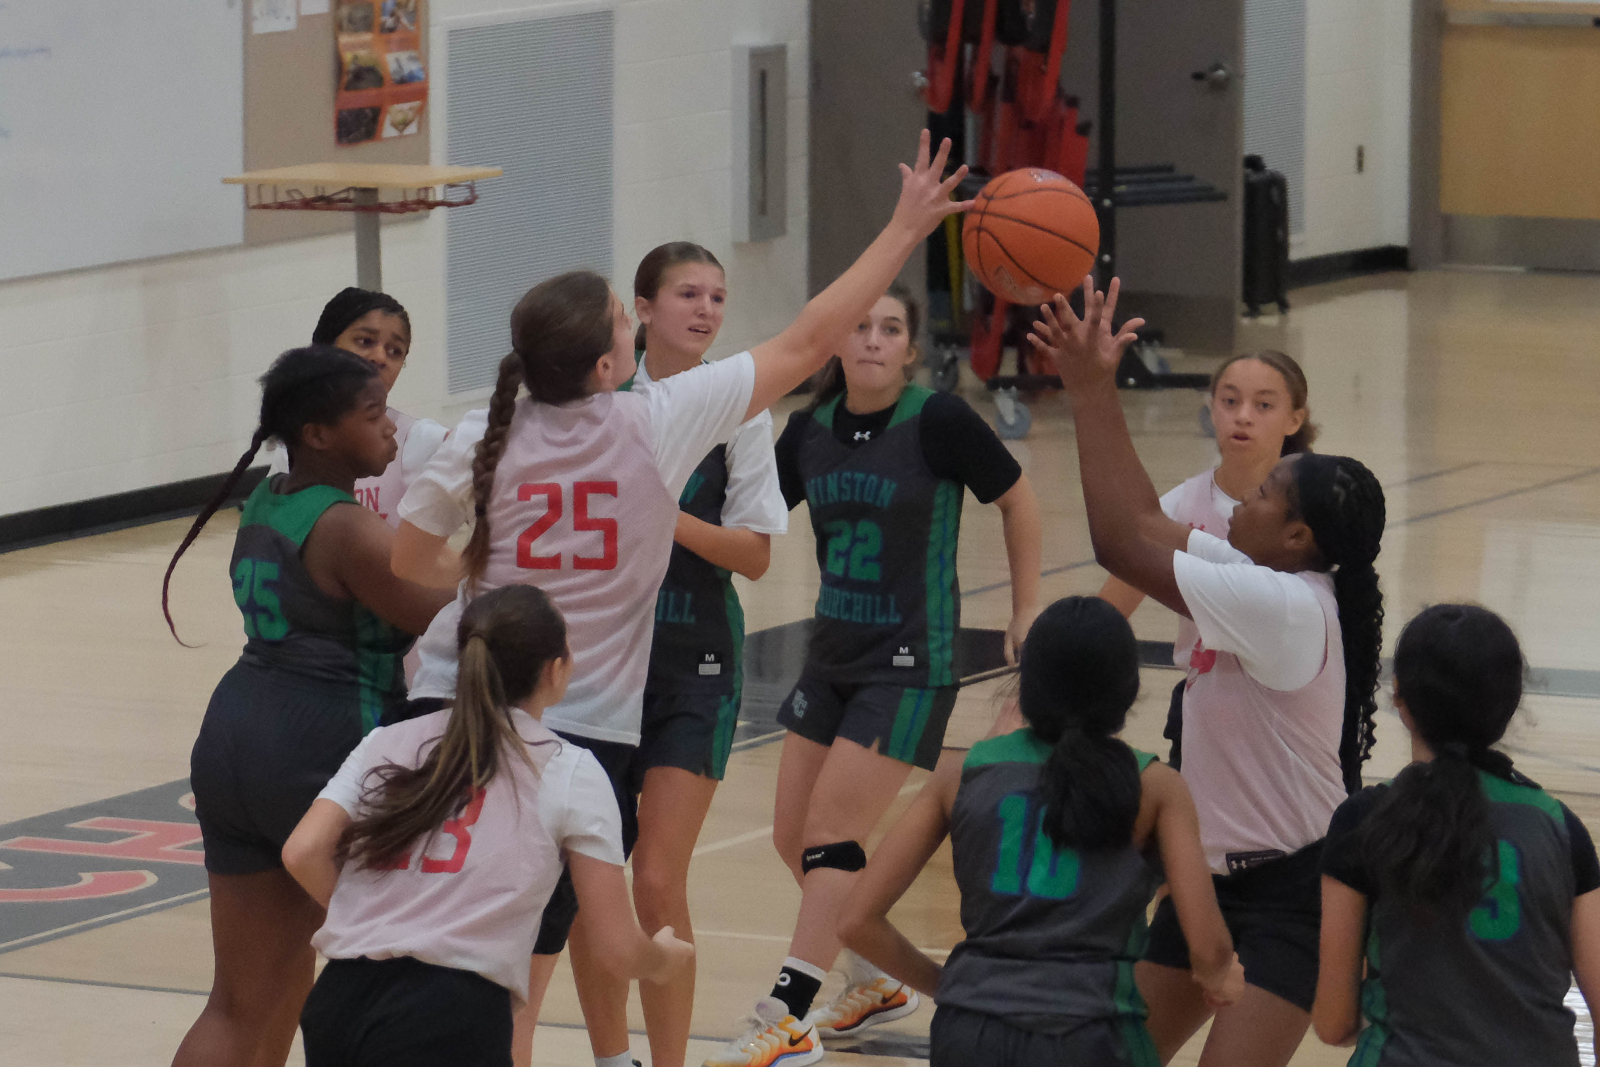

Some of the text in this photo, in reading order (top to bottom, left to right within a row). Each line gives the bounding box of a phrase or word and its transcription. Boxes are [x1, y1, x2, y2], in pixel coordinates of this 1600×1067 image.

[516, 480, 618, 571] 25
[823, 518, 883, 581] 22
[705, 653, 715, 662] M
[899, 646, 909, 654] M
